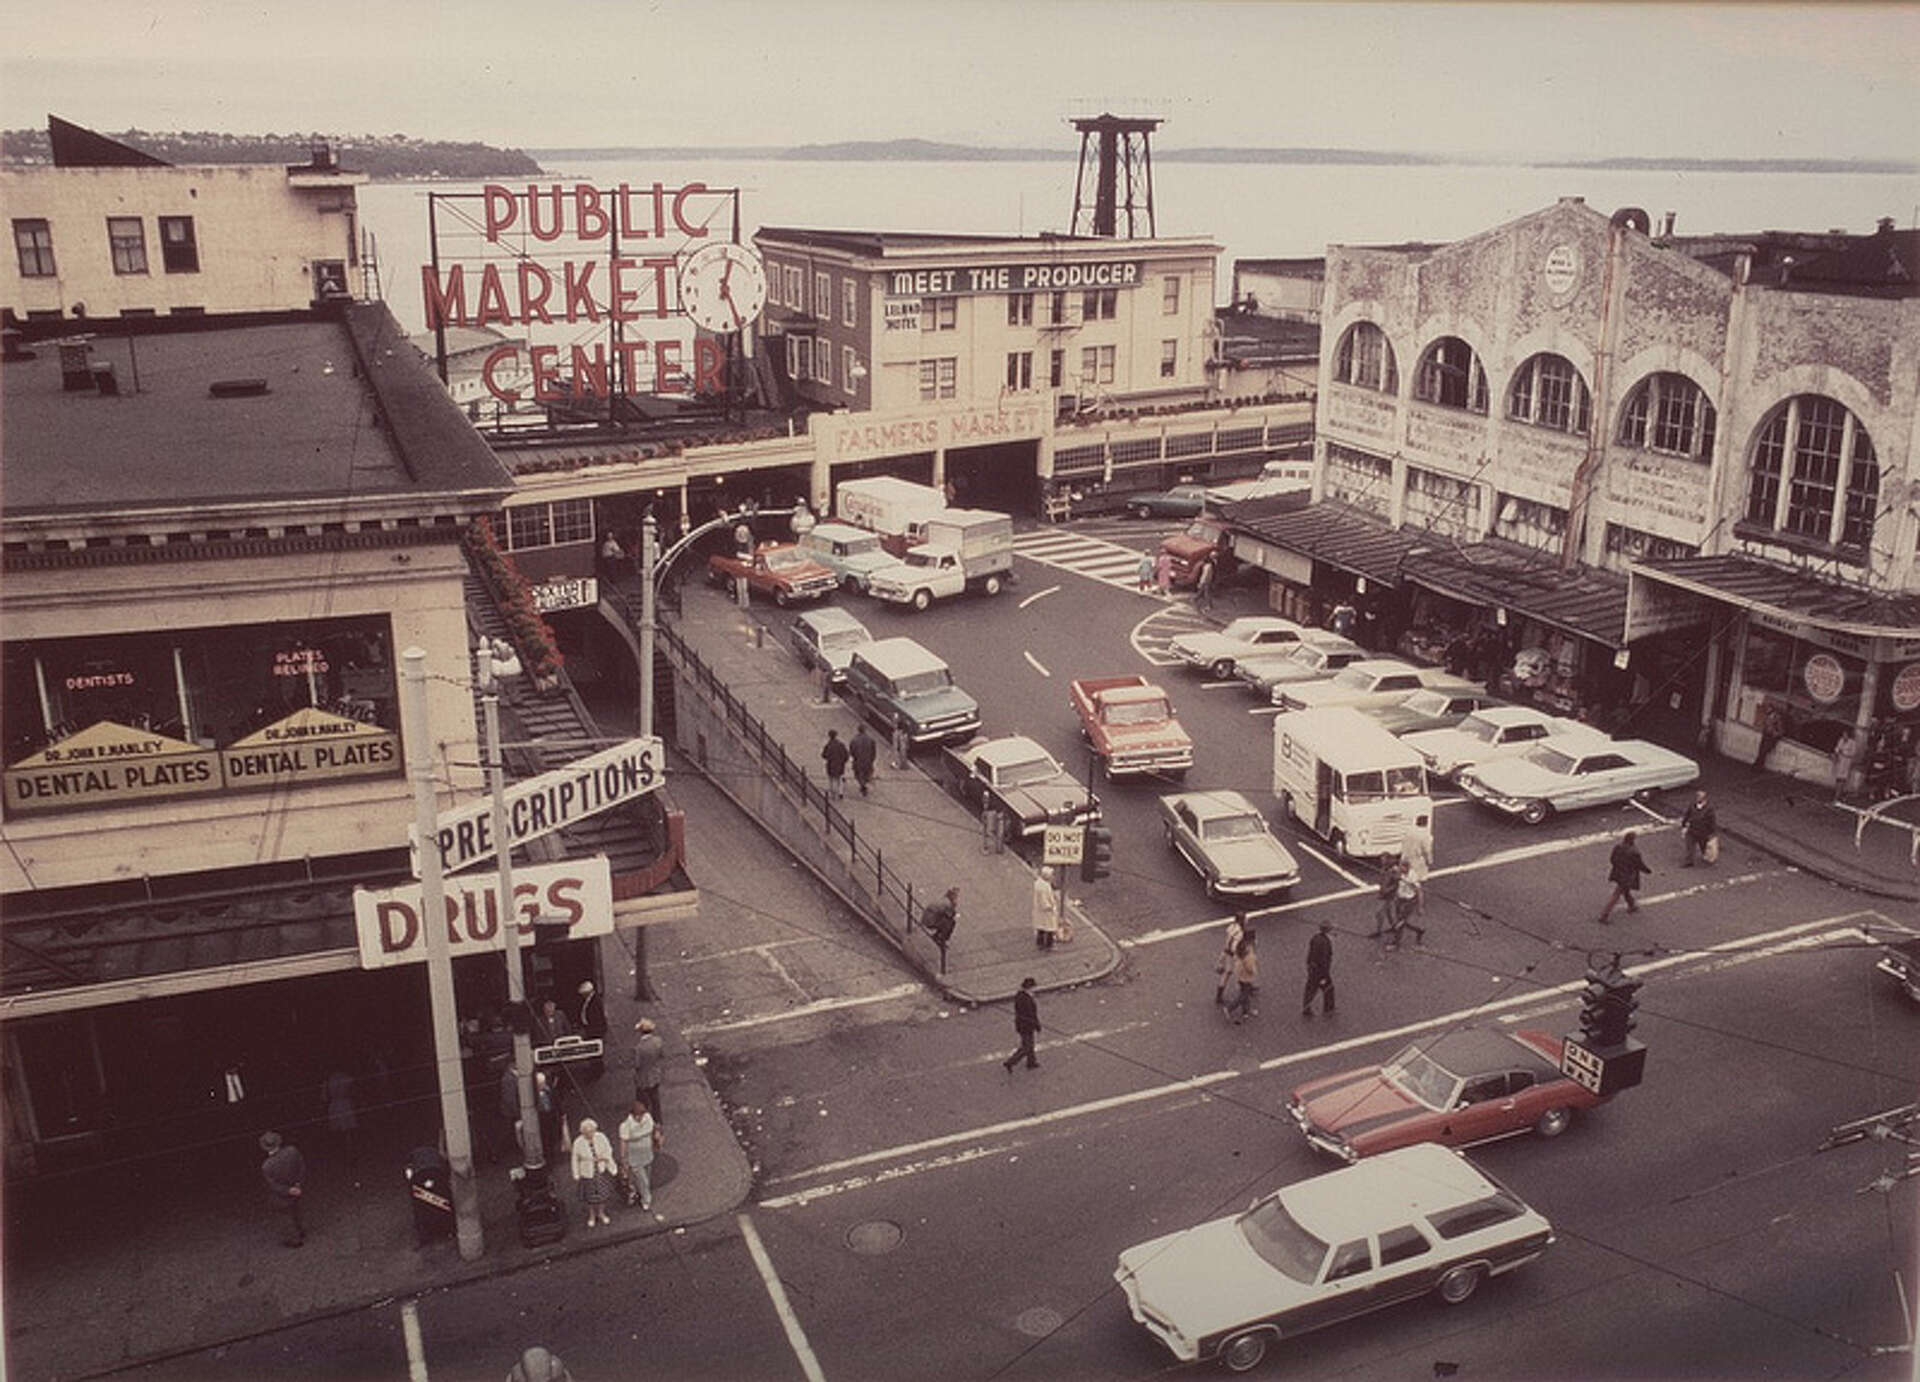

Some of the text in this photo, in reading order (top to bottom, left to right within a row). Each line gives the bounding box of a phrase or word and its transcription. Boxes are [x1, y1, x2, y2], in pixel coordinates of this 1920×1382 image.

[484, 182, 709, 243] PUBLIC
[421, 257, 678, 331] MARKET
[893, 263, 1137, 294] MEET THE PRODUCER
[482, 338, 727, 404] CENTER
[836, 407, 1040, 451] FARMERS MARKET
[66, 673, 135, 690] DENTISTS
[229, 741, 394, 778] DENTAL PLATES
[16, 760, 211, 800] DENTAL PLATES
[1048, 831, 1081, 843] DO NOT
[1048, 845, 1081, 857] ENTER
[1569, 1044, 1600, 1071] ONE
[1566, 1065, 1598, 1088] WAY
